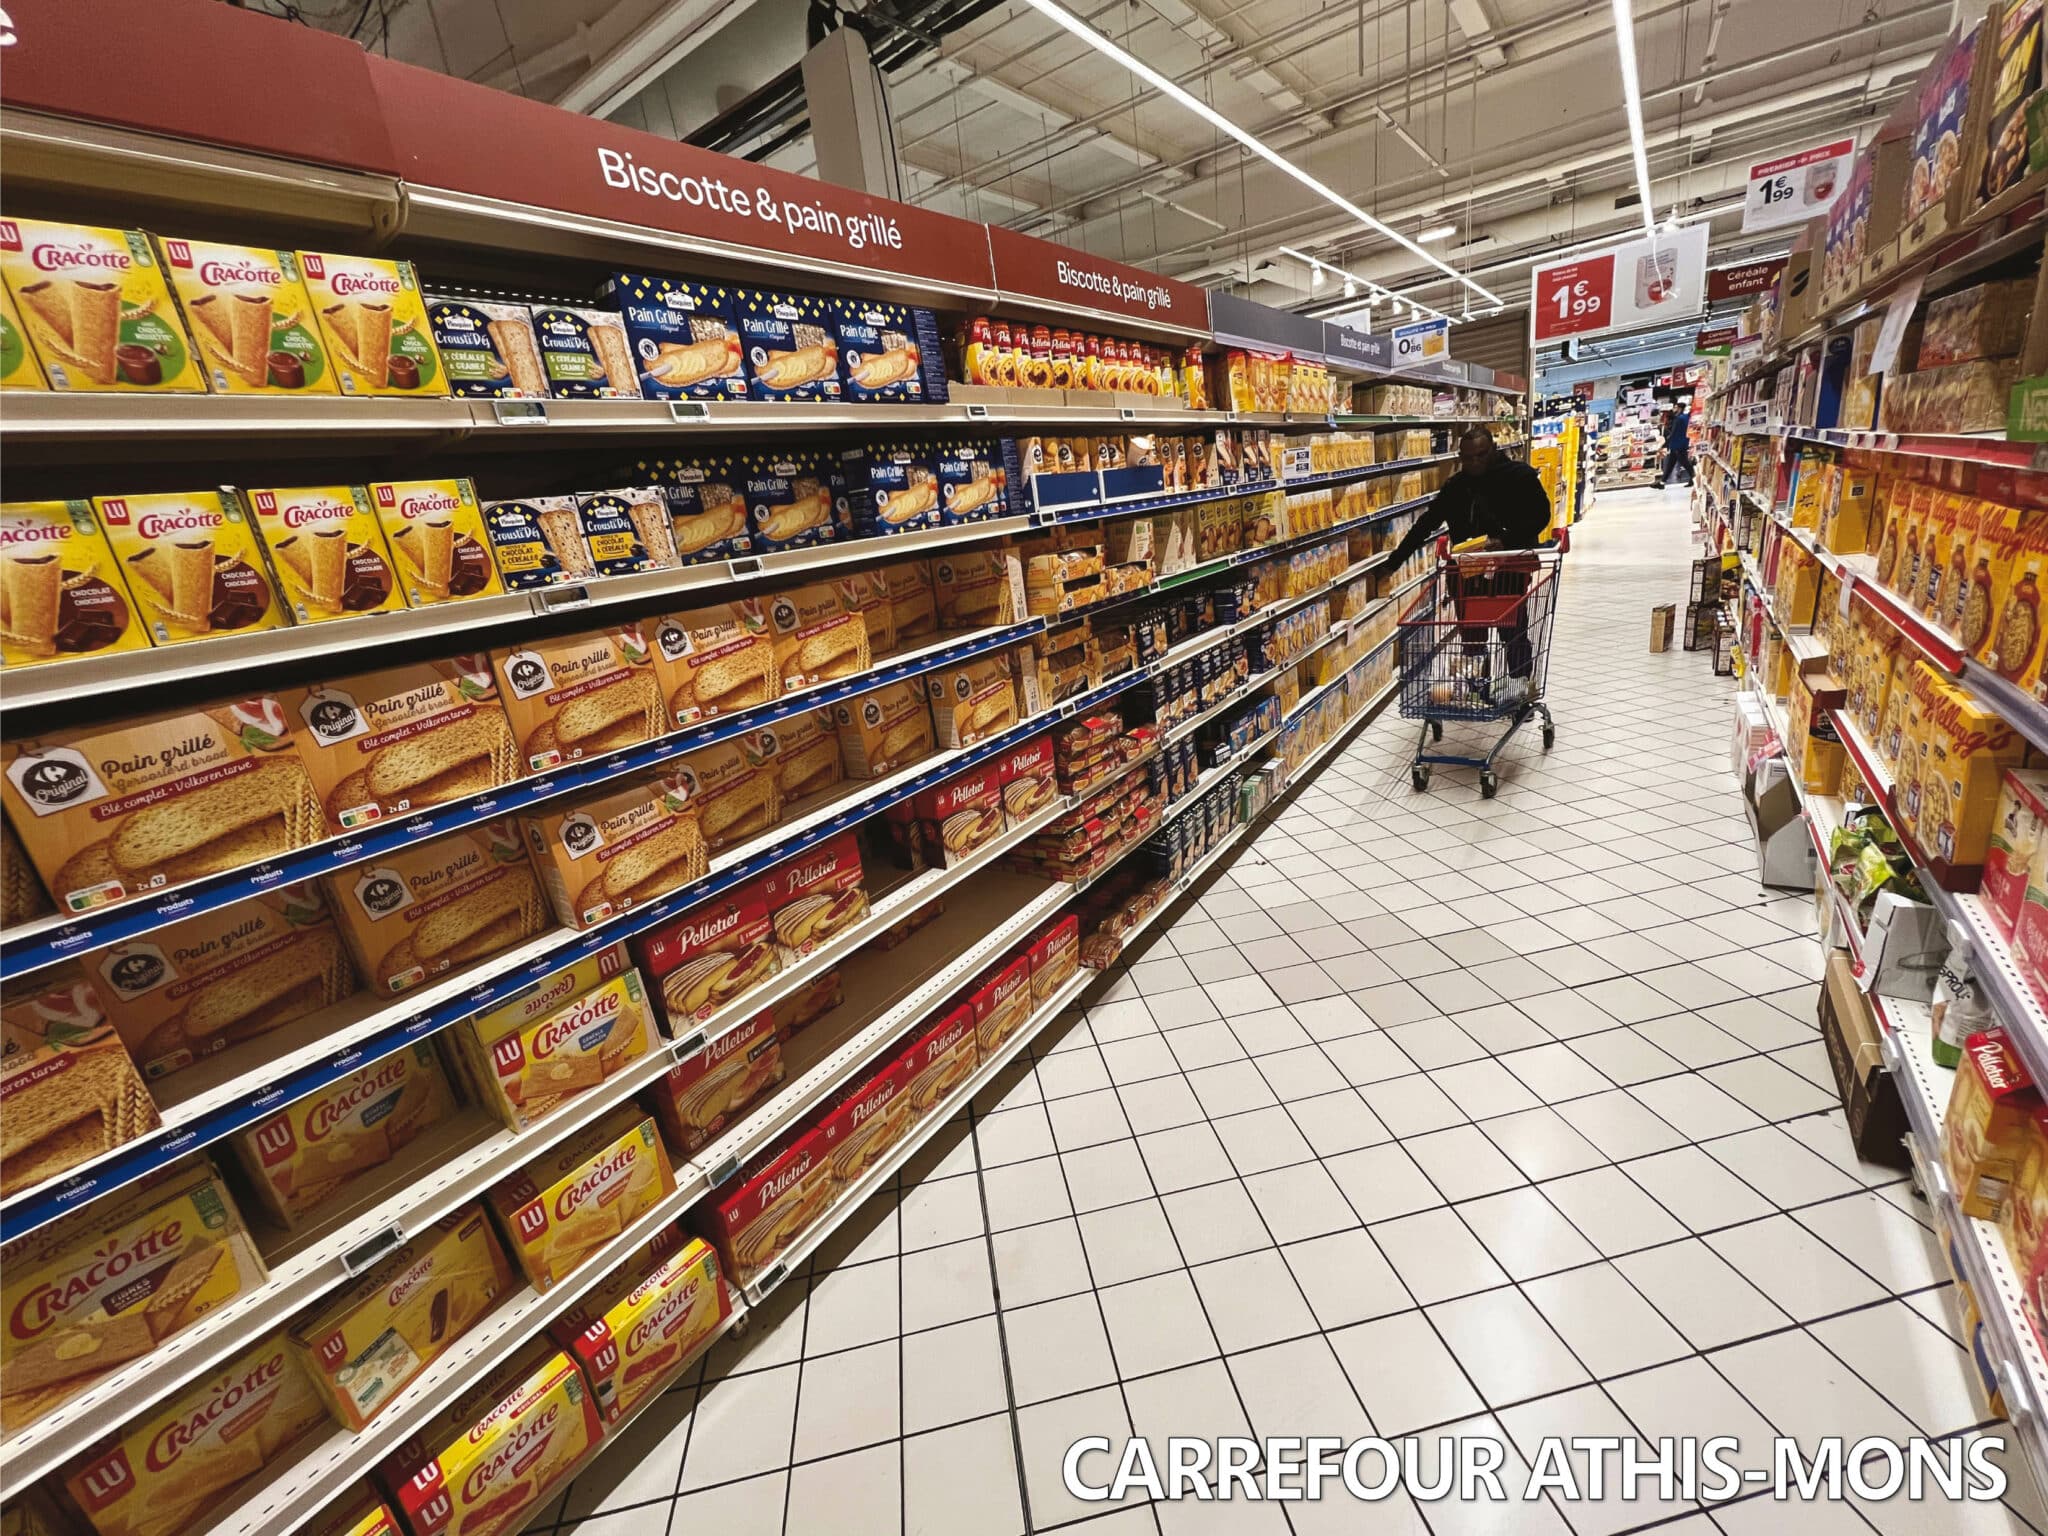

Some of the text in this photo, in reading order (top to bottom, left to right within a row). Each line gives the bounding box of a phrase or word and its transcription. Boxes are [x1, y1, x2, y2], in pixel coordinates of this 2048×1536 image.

[597, 147, 903, 251] Biscotte & pain grillé
[1759, 175, 1794, 205] 1 € 99
[168, 242, 190, 261] LU
[305, 257, 322, 273] LU
[1056, 260, 1172, 309] Biscotte & pain grillé
[1727, 266, 1769, 281] Céréale
[1728, 277, 1764, 291] enfant
[1551, 280, 1601, 319] 1 € 99
[628, 306, 685, 325] Pain Grillé
[743, 317, 789, 334] Pain Grillé
[840, 323, 879, 339] Pain Grillé
[871, 464, 904, 479] Pain Grillé
[940, 462, 954, 473] Pain
[378, 486, 393, 502] LU
[747, 477, 789, 493] Pain Grillé
[102, 501, 125, 520] LU
[257, 493, 274, 511] LU
[691, 627, 716, 642] Pain
[551, 647, 611, 677] Pain grillé
[363, 682, 445, 719] Pain grillé
[101, 734, 216, 779] Pain grillé
[363, 738, 379, 750] Blé
[1011, 749, 1042, 775] Pelletier
[99, 801, 123, 818] Blé
[124, 788, 169, 811] complet
[175, 771, 224, 793] Volkoren
[951, 778, 985, 807] Pelletier
[600, 801, 656, 834] Pain grillé
[410, 853, 480, 891] Pain grillé
[787, 858, 839, 895] Pelletier
[766, 881, 776, 894] LU
[678, 910, 741, 955] Pelletier
[1046, 929, 1072, 959] Pelletier
[652, 940, 665, 956] LU
[993, 973, 1022, 1007] Pelletier
[495, 1038, 521, 1067] LU
[704, 1020, 757, 1069] Pelletier
[927, 1023, 964, 1062] Pelletier
[1972, 1040, 2009, 1090] Pelletier
[851, 1083, 895, 1128] Pelletier
[259, 1125, 291, 1155] LU
[826, 1125, 836, 1139] LU
[758, 1155, 813, 1209] Pelletier
[519, 1205, 545, 1234] LU
[727, 1208, 740, 1223] LU
[584, 1319, 607, 1342] LU
[322, 1336, 344, 1360] LU
[595, 1344, 617, 1372] LU
[85, 1458, 127, 1498] LU
[412, 1461, 440, 1491] LU
[420, 1495, 450, 1527] LU
